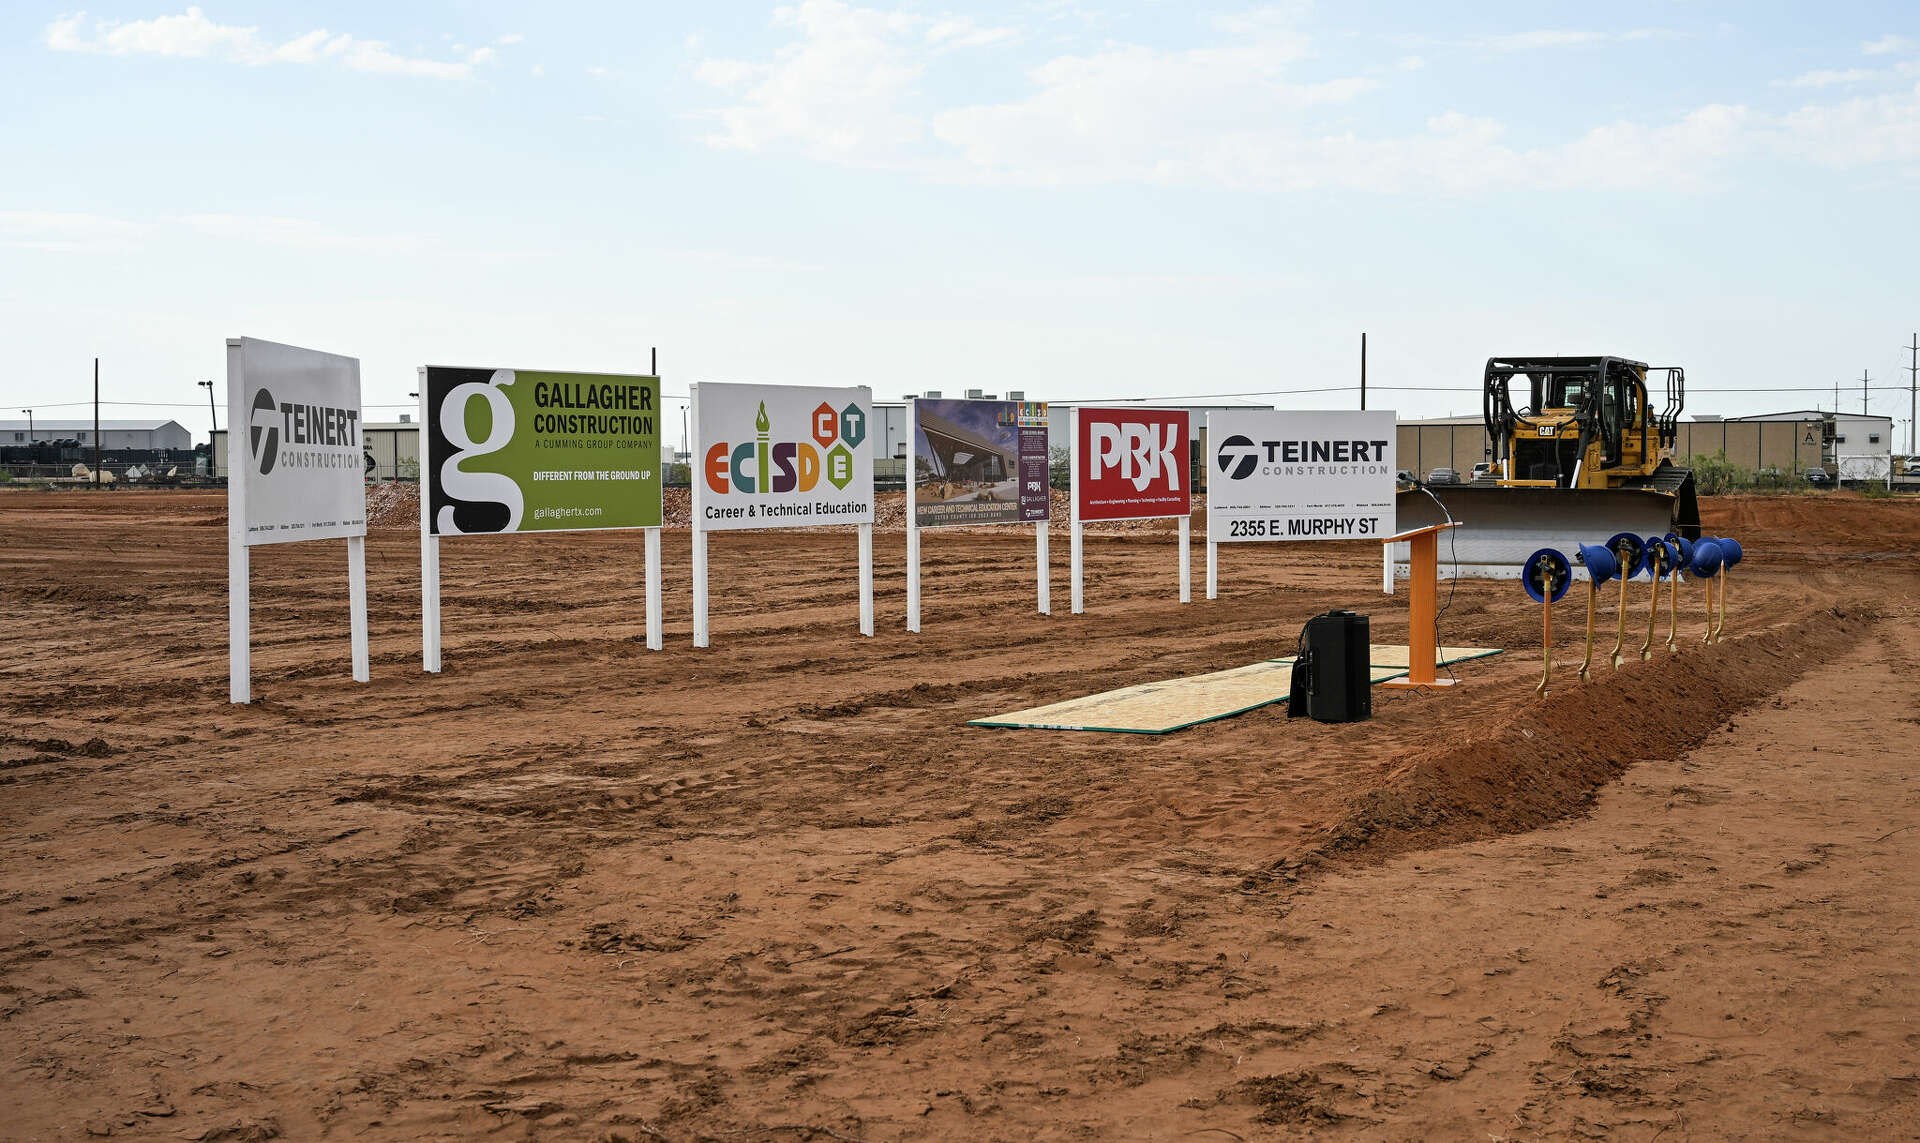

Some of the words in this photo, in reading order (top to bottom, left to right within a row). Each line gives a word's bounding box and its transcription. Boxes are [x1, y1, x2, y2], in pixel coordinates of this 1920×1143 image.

[534, 382, 653, 410] GALLAGHER
[280, 402, 358, 447] TEINERT
[534, 414, 653, 434] CONSTRUCTION
[1539, 426, 1555, 436] CAT
[535, 439, 540, 449] A
[543, 439, 583, 449] CUMMING
[586, 439, 613, 449] GROUP
[616, 439, 653, 449] COMPANY
[1262, 440, 1389, 463] TEINERT
[281, 451, 360, 469] CONSTRUCTION
[1090, 422, 1180, 492] PBK
[533, 471, 573, 481] DIFFERENT
[574, 470, 595, 481] FROM
[596, 470, 610, 480] THE
[610, 470, 640, 480] GROUND
[641, 470, 651, 480] UP
[1262, 466, 1389, 476] CONSTRUCTION
[534, 507, 602, 520] gallaghertx.com
[705, 506, 745, 519] Career
[748, 505, 756, 517] &
[760, 502, 812, 517] Technical
[816, 501, 867, 515] Education
[1002, 502, 1018, 511] CENTER
[1230, 520, 1266, 537] 2355
[1269, 519, 1284, 536] E.
[1288, 518, 1356, 536] MURPHY
[1358, 517, 1379, 534] ST
